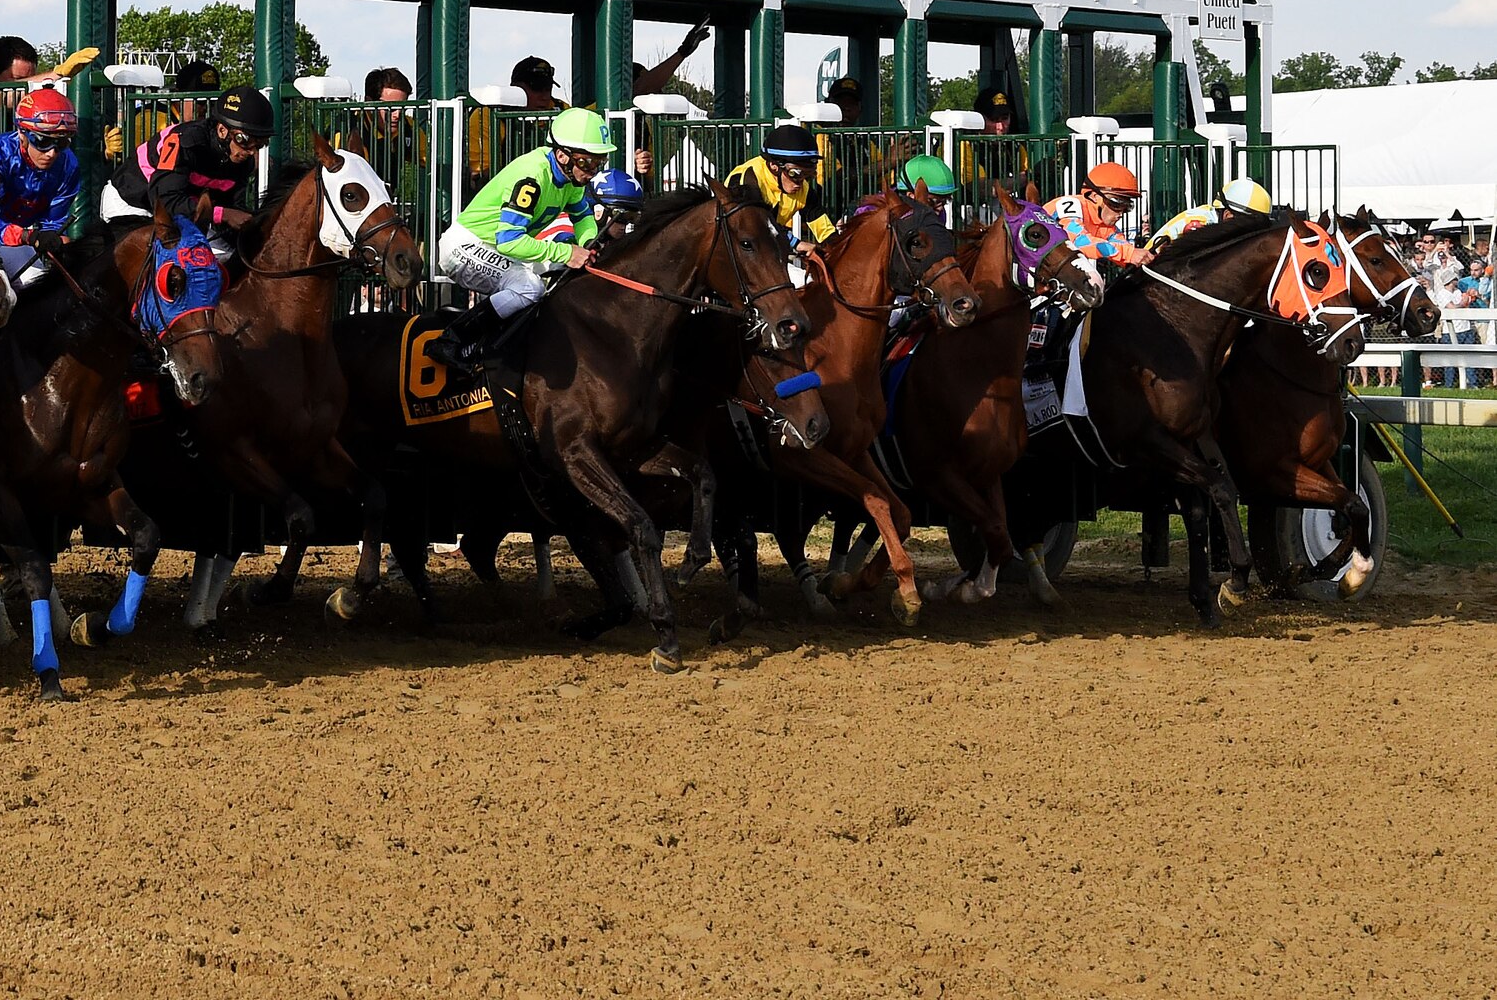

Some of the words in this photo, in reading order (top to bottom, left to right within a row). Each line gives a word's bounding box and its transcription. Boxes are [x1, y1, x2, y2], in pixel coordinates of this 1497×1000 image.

[1207, 12, 1236, 30] Puett
[162, 142, 176, 164] 7
[517, 185, 536, 208] 6
[1061, 200, 1077, 214] 2
[408, 329, 447, 399] 6
[413, 402, 433, 417] RIA
[437, 386, 492, 413] ANTONIA
